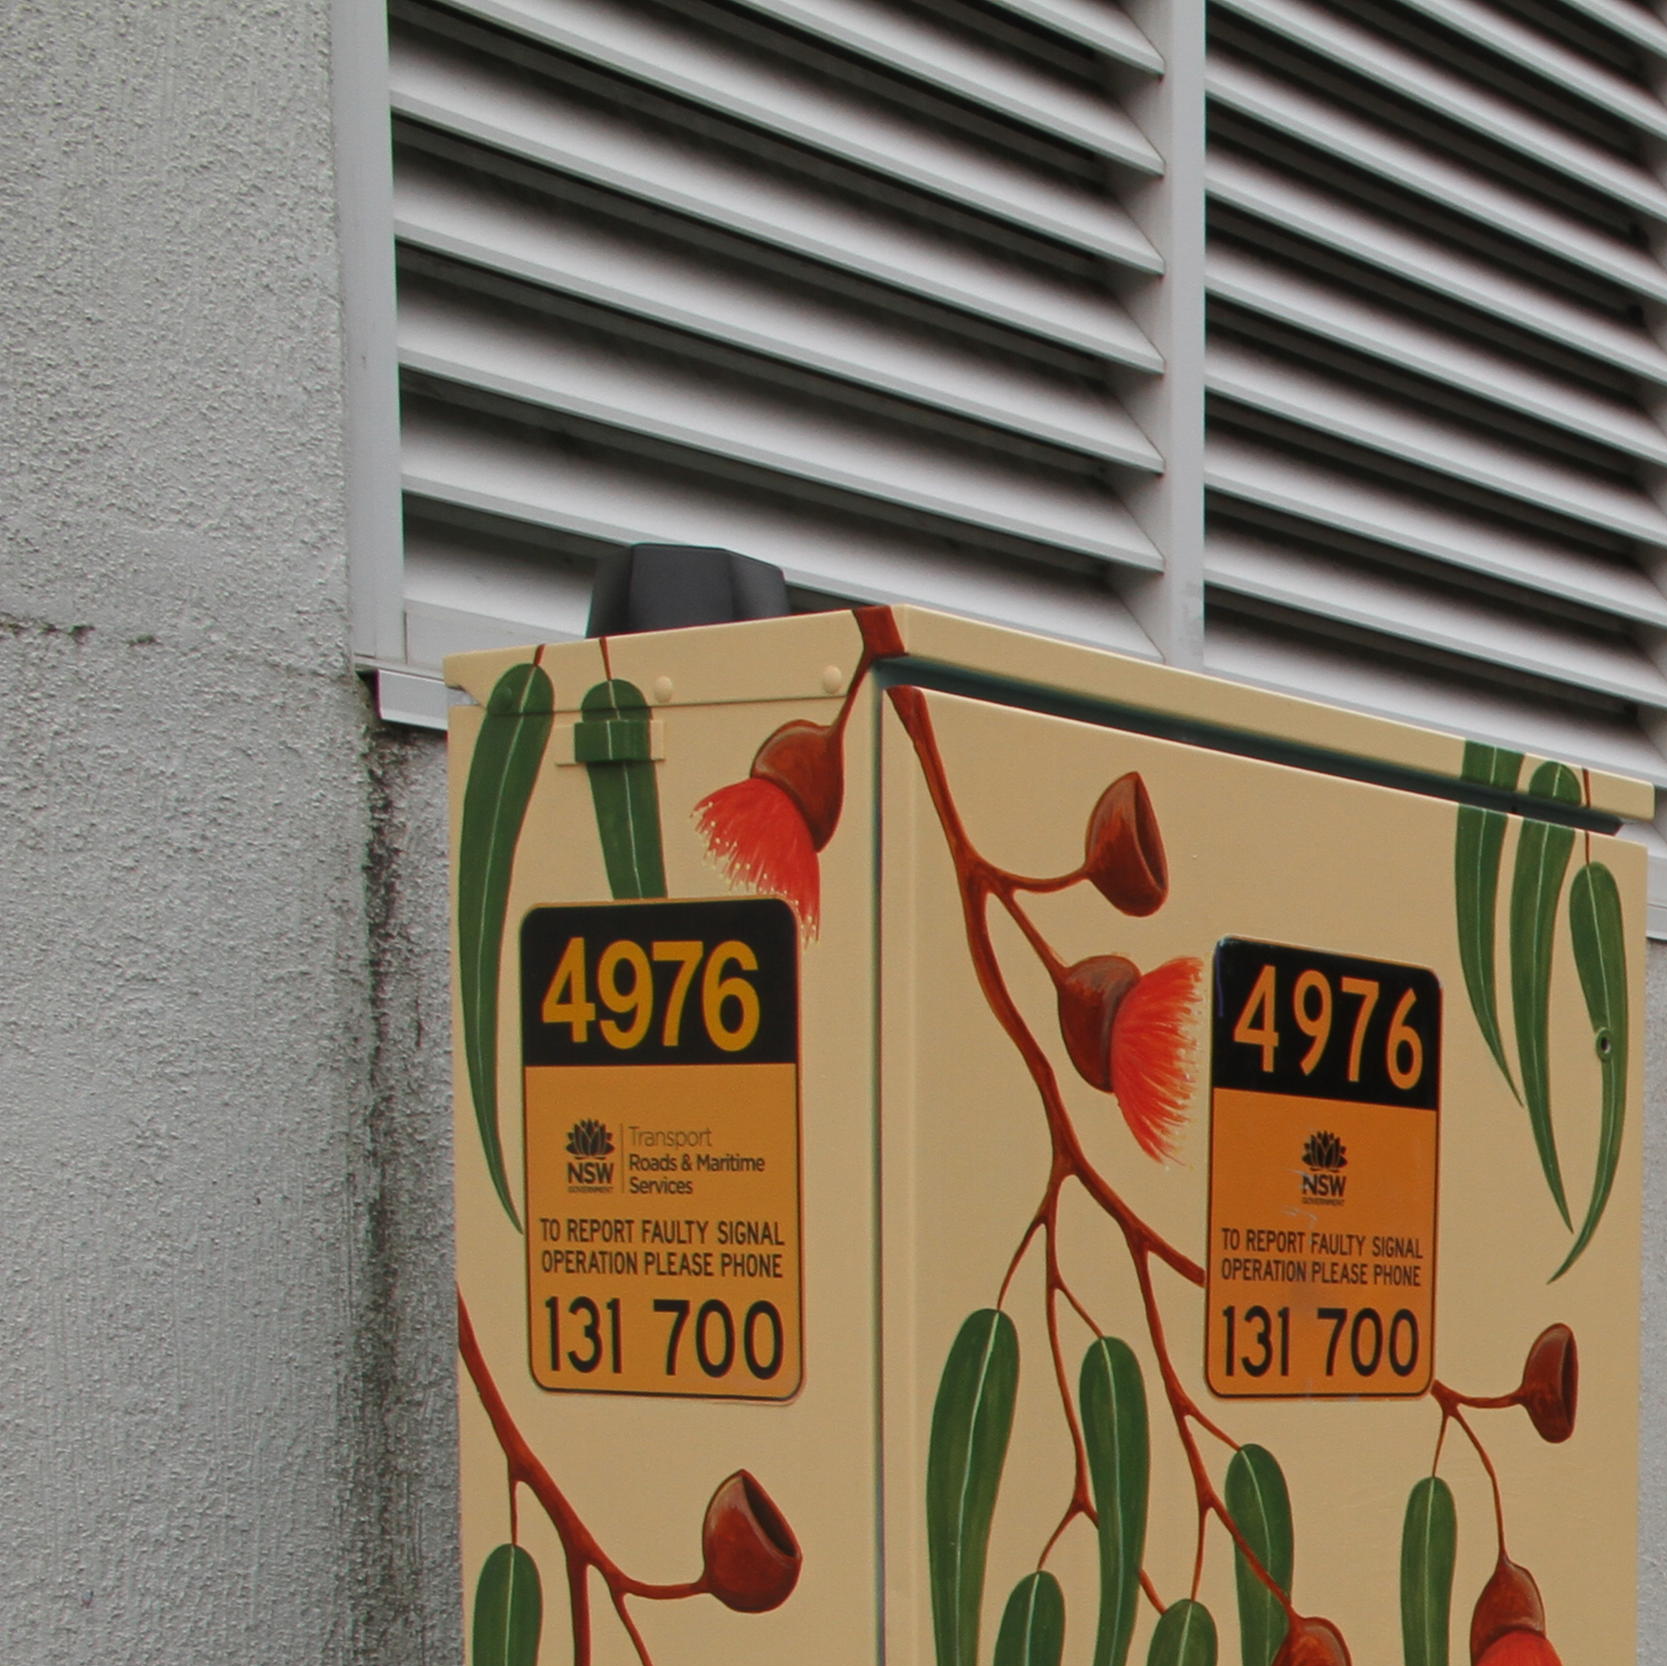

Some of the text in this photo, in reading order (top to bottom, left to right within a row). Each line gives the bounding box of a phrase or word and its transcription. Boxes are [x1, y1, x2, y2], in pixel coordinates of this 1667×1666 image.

[541, 936, 760, 1052] 4976
[1233, 964, 1424, 1090] 4976
[628, 1125, 713, 1149] Transport
[566, 1162, 614, 1184] NSW
[628, 1153, 766, 1172] Roads & Maritime
[629, 1176, 694, 1195] Services
[1302, 1174, 1347, 1197] NSW
[540, 1218, 785, 1246] TO REPORT FAULTY SIGNAL
[1221, 1228, 1423, 1259] TO REPORT FAULTY SIGNAL
[542, 1250, 783, 1278] OPERATION PLEASE PHONE
[1221, 1258, 1421, 1287] OPERATION PLEASE PHONE
[545, 1295, 784, 1380] 131 700
[1223, 1305, 1420, 1378] 131 700
